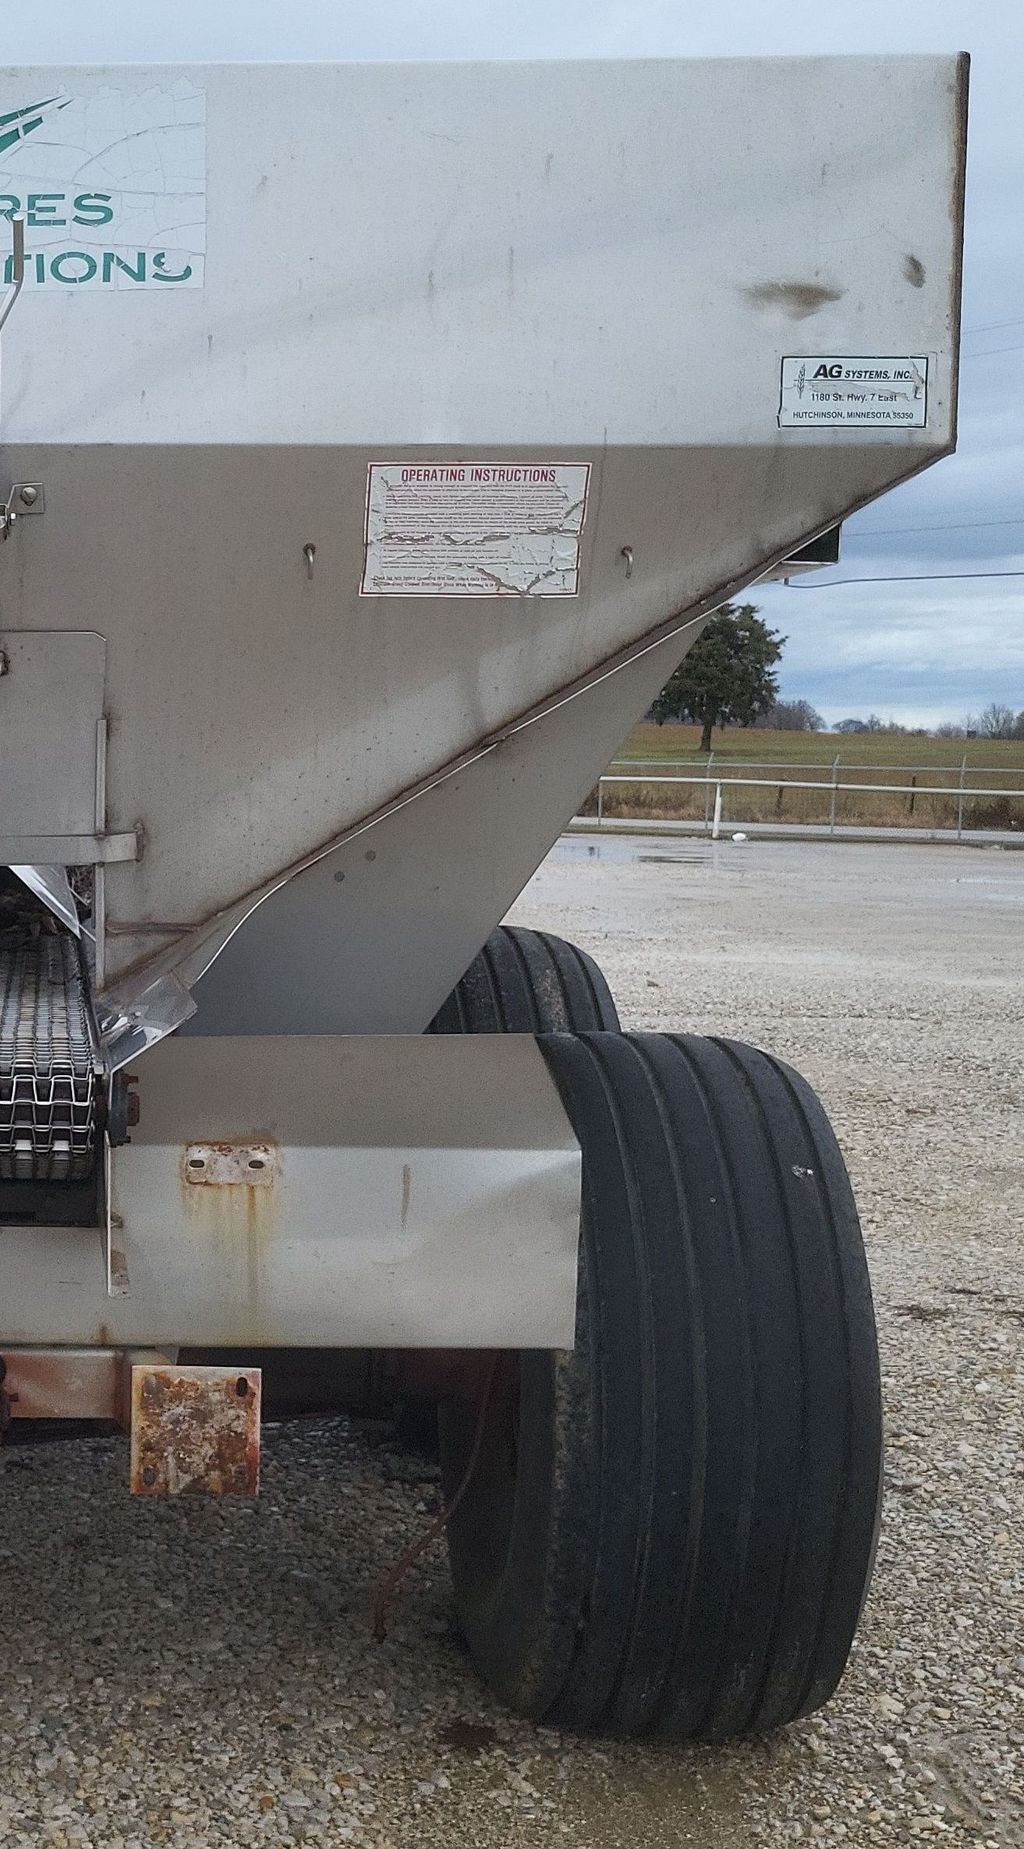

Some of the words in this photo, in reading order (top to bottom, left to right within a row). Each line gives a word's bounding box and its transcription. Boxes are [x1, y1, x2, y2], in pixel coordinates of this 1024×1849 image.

[812, 364, 844, 379] AG
[844, 370, 891, 380] SYSTEMS,
[893, 370, 913, 379] INC.
[811, 393, 831, 402] 1180
[847, 393, 868, 403] Hwy.
[870, 393, 876, 401] 7
[878, 393, 897, 402] East
[792, 411, 845, 419] HUTCHINSON,
[401, 469, 465, 482] OPERATING
[470, 469, 556, 482] INSTRUCTIONS
